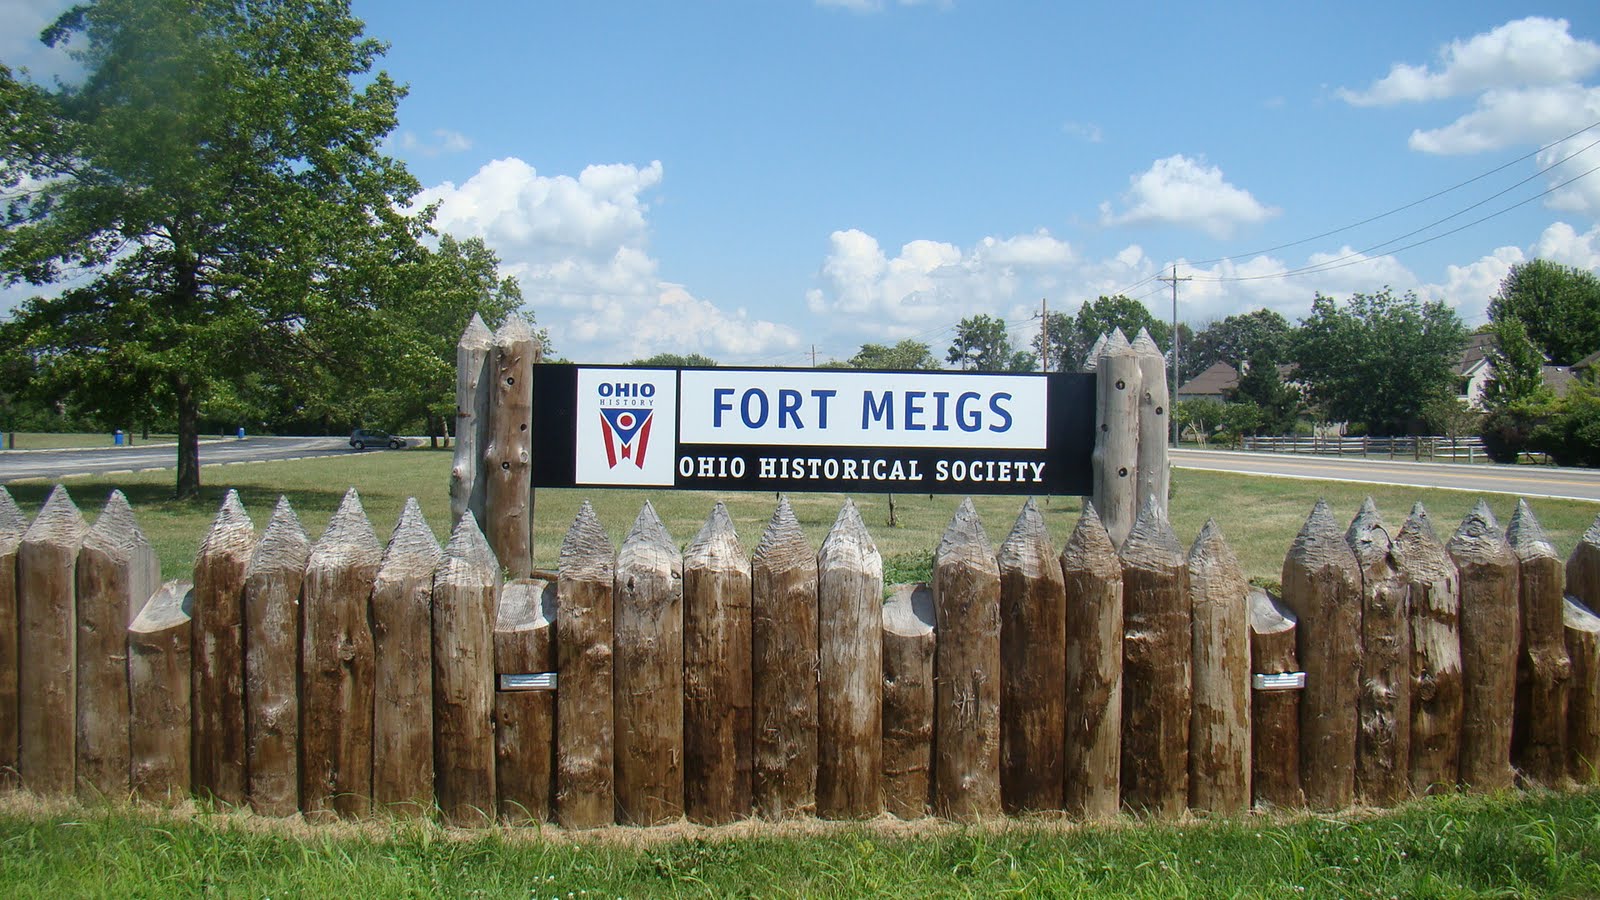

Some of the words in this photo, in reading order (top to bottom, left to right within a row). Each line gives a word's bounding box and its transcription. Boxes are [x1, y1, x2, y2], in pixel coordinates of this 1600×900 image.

[598, 383, 655, 397] OHIO
[713, 388, 837, 429] FORT
[862, 391, 1013, 433] MEIGS
[679, 456, 746, 478] OHIO
[759, 457, 923, 480] HISTORICAL
[935, 460, 1046, 482] SOCIETY
